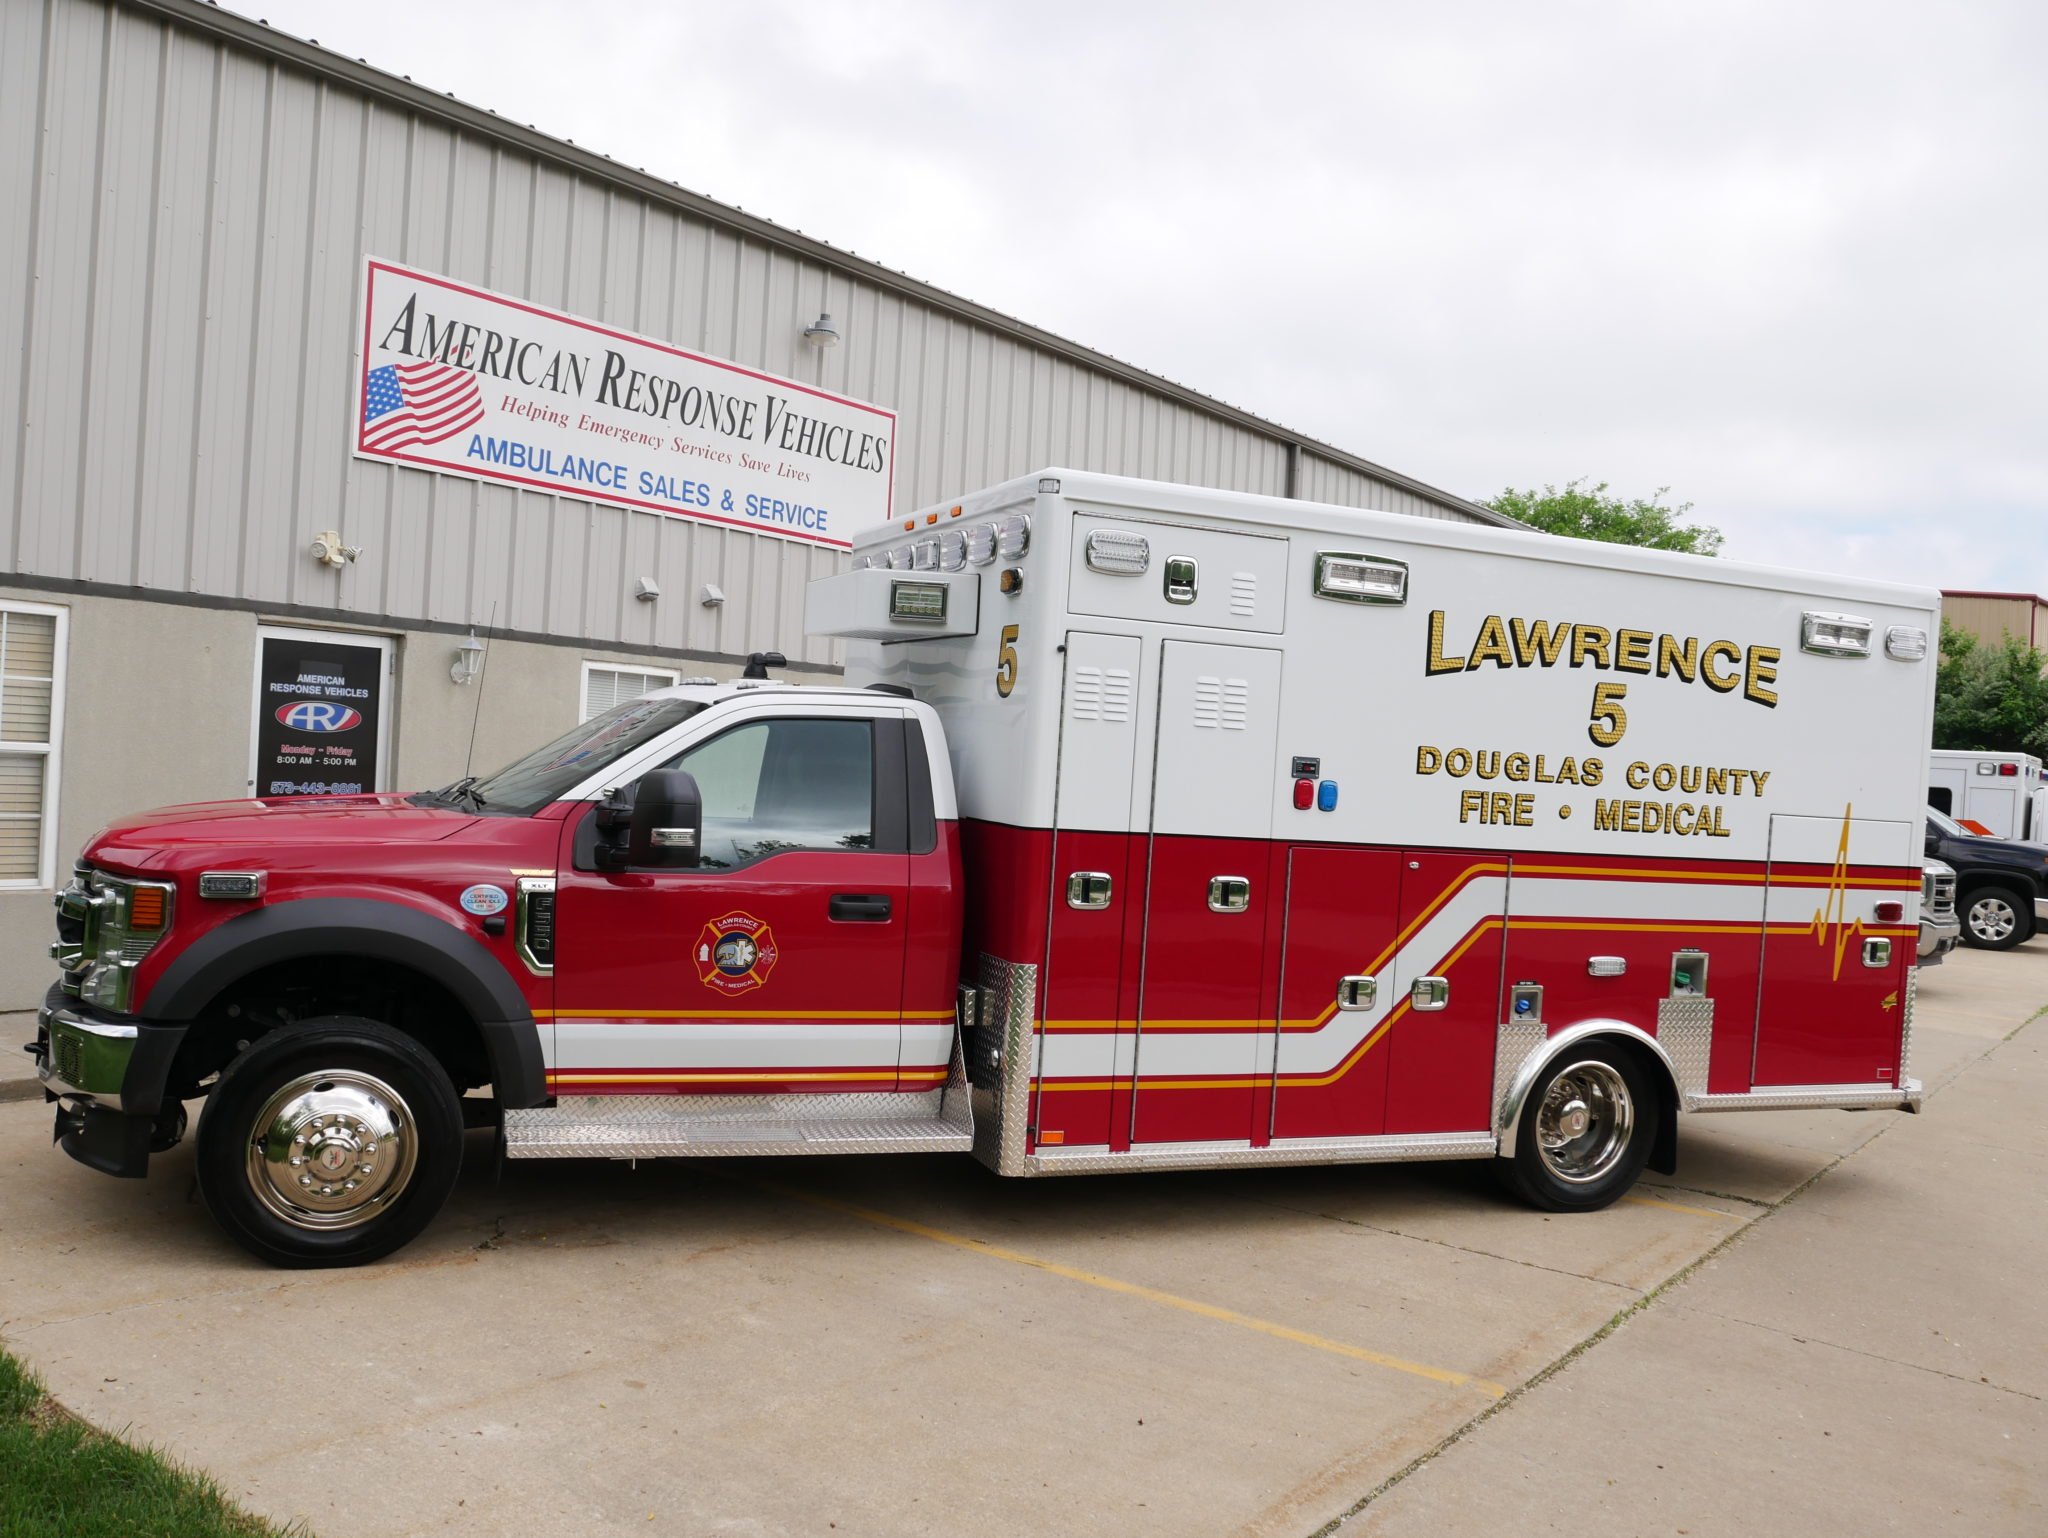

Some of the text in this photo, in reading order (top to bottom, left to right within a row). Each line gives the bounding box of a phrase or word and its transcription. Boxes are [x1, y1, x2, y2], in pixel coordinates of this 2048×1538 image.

[379, 291, 888, 474] AMERICAN RESPONSE VEHICLES
[501, 395, 812, 483] Helping Emergency Services Save Lives
[466, 433, 829, 531] AMBULANCE SALES & SERVICE
[297, 674, 345, 685] AMERICAN
[996, 623, 1020, 699] 5
[1425, 609, 1781, 709] LAWRENCE
[270, 683, 368, 698] RESPONSE VEHICLES
[1588, 681, 1628, 748] 5
[285, 703, 353, 730] ARV
[277, 756, 296, 764] 8:00
[299, 756, 312, 765] AM
[322, 757, 342, 766] 5:00
[344, 758, 357, 766] PM
[281, 745, 316, 755] Monday
[326, 746, 353, 758] Friday
[1416, 745, 1771, 797] DOUGLAS COUNTY
[1460, 789, 1535, 827] FIRE
[1593, 798, 1731, 837] MEDICAL
[717, 918, 758, 928] LAWRENCE
[711, 976, 725, 987] FIRE
[728, 979, 755, 989] MEDICAL
